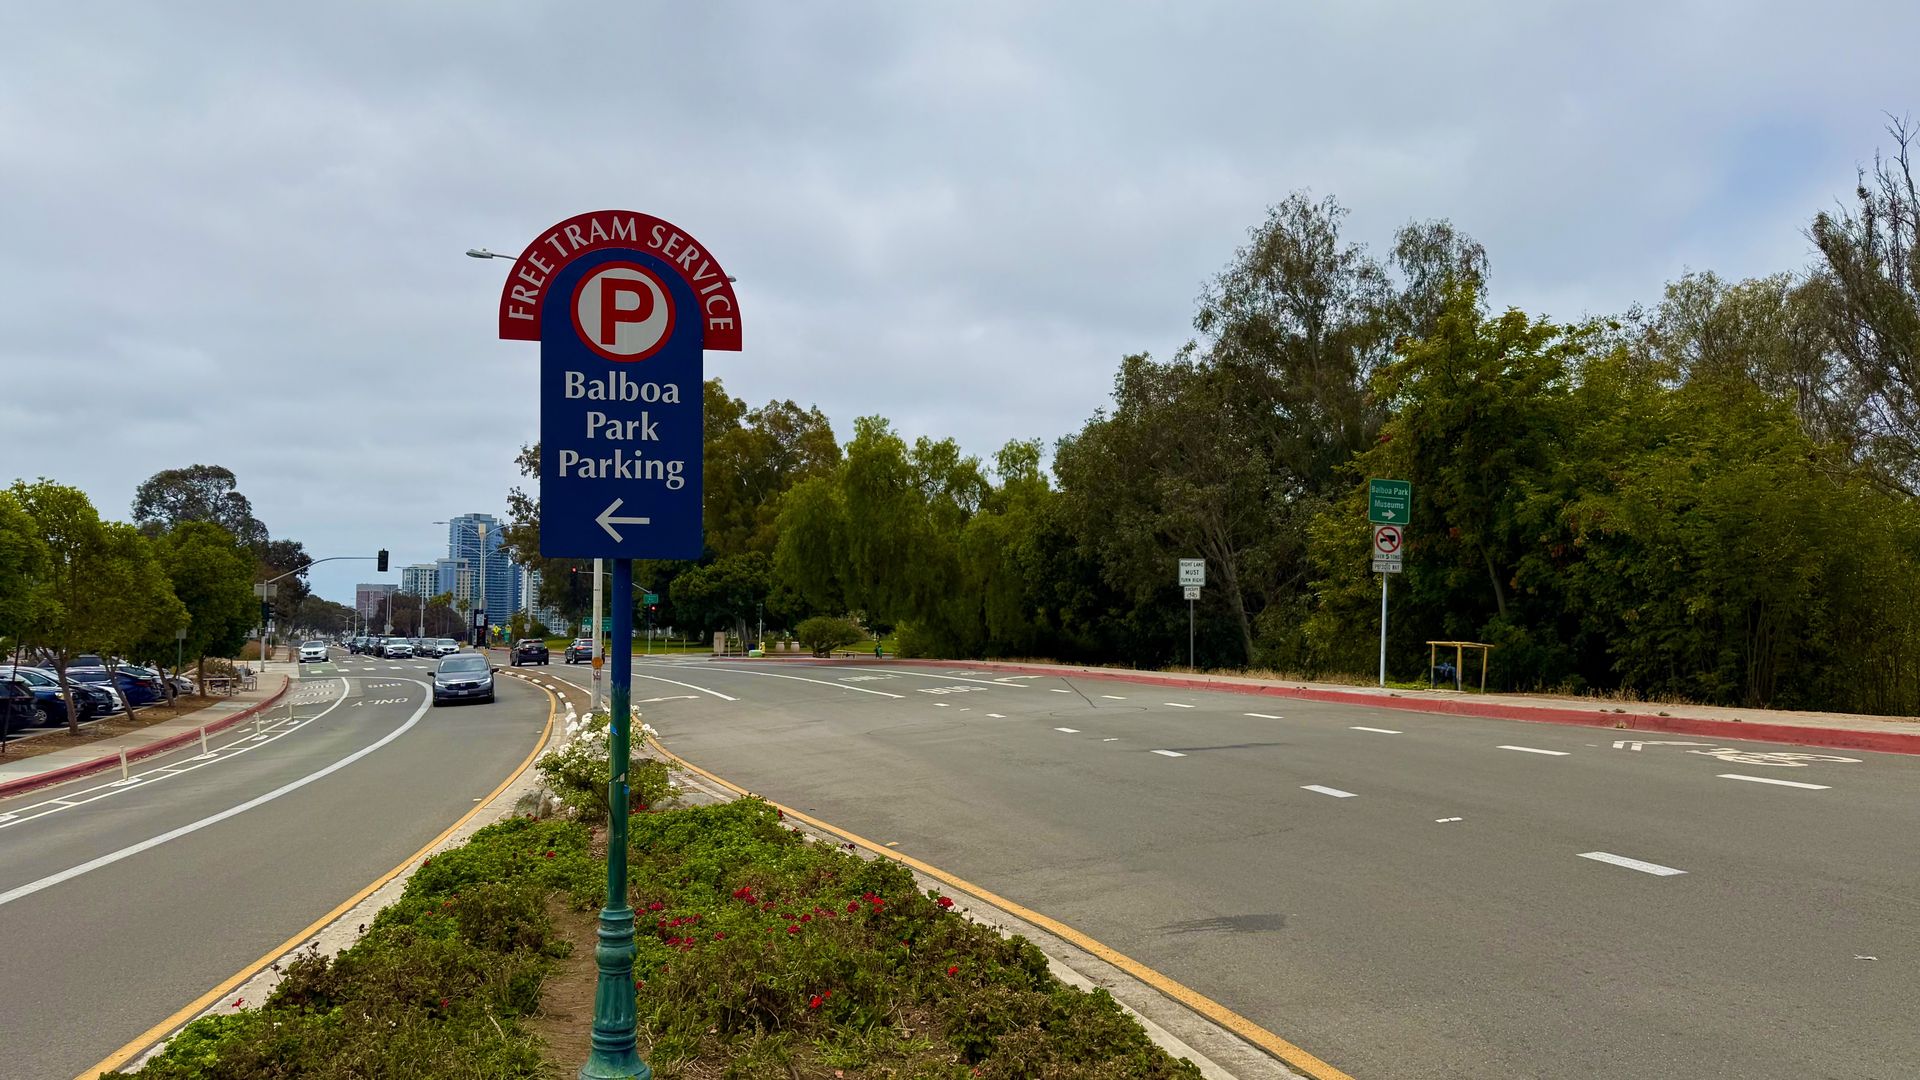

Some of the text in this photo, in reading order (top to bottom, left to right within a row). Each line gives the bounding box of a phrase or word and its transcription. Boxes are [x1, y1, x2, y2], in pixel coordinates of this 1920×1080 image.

[508, 215, 734, 331] FREE TRAM SERVICE
[599, 277, 655, 346] P
[564, 370, 681, 404] Balboa
[586, 411, 660, 442] Park
[559, 449, 685, 490] Parking
[1371, 485, 1409, 496] Balboa Park
[1374, 499, 1405, 510] Museums
[351, 697, 409, 708] ONLY
